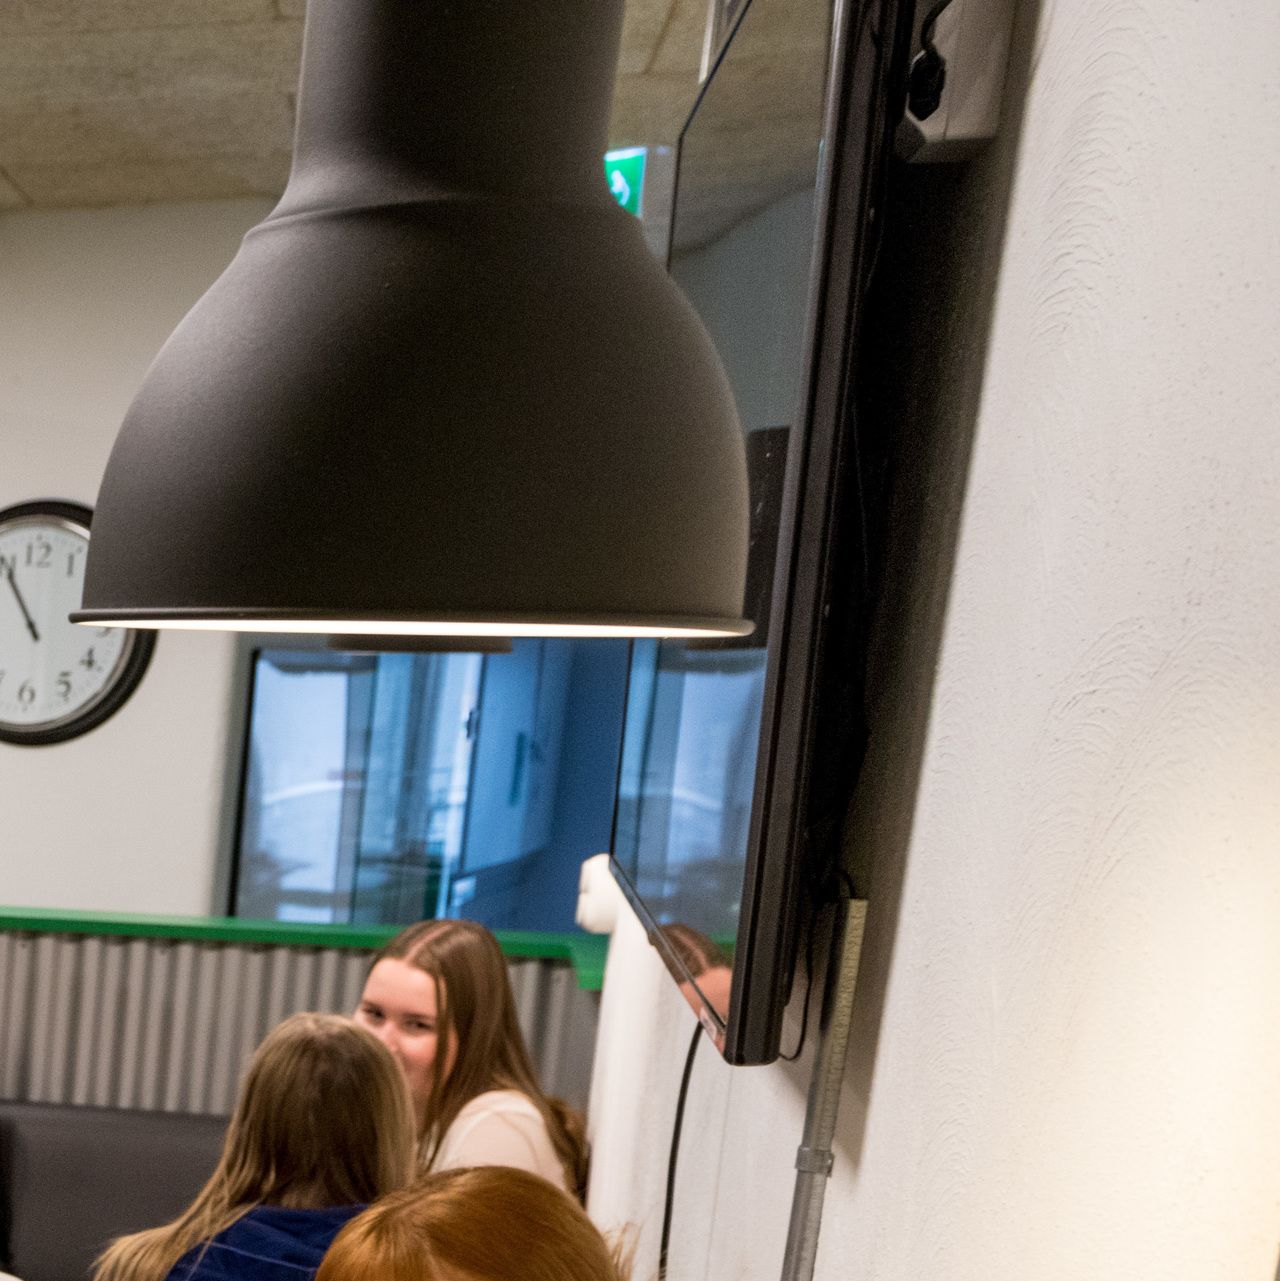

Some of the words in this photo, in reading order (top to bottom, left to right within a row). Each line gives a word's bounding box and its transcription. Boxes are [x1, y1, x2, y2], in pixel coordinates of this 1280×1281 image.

[26, 541, 52, 568] 12
[66, 553, 75, 577] 1
[80, 647, 95, 671] 4
[18, 680, 35, 704] 6
[55, 672, 72, 697] 5
